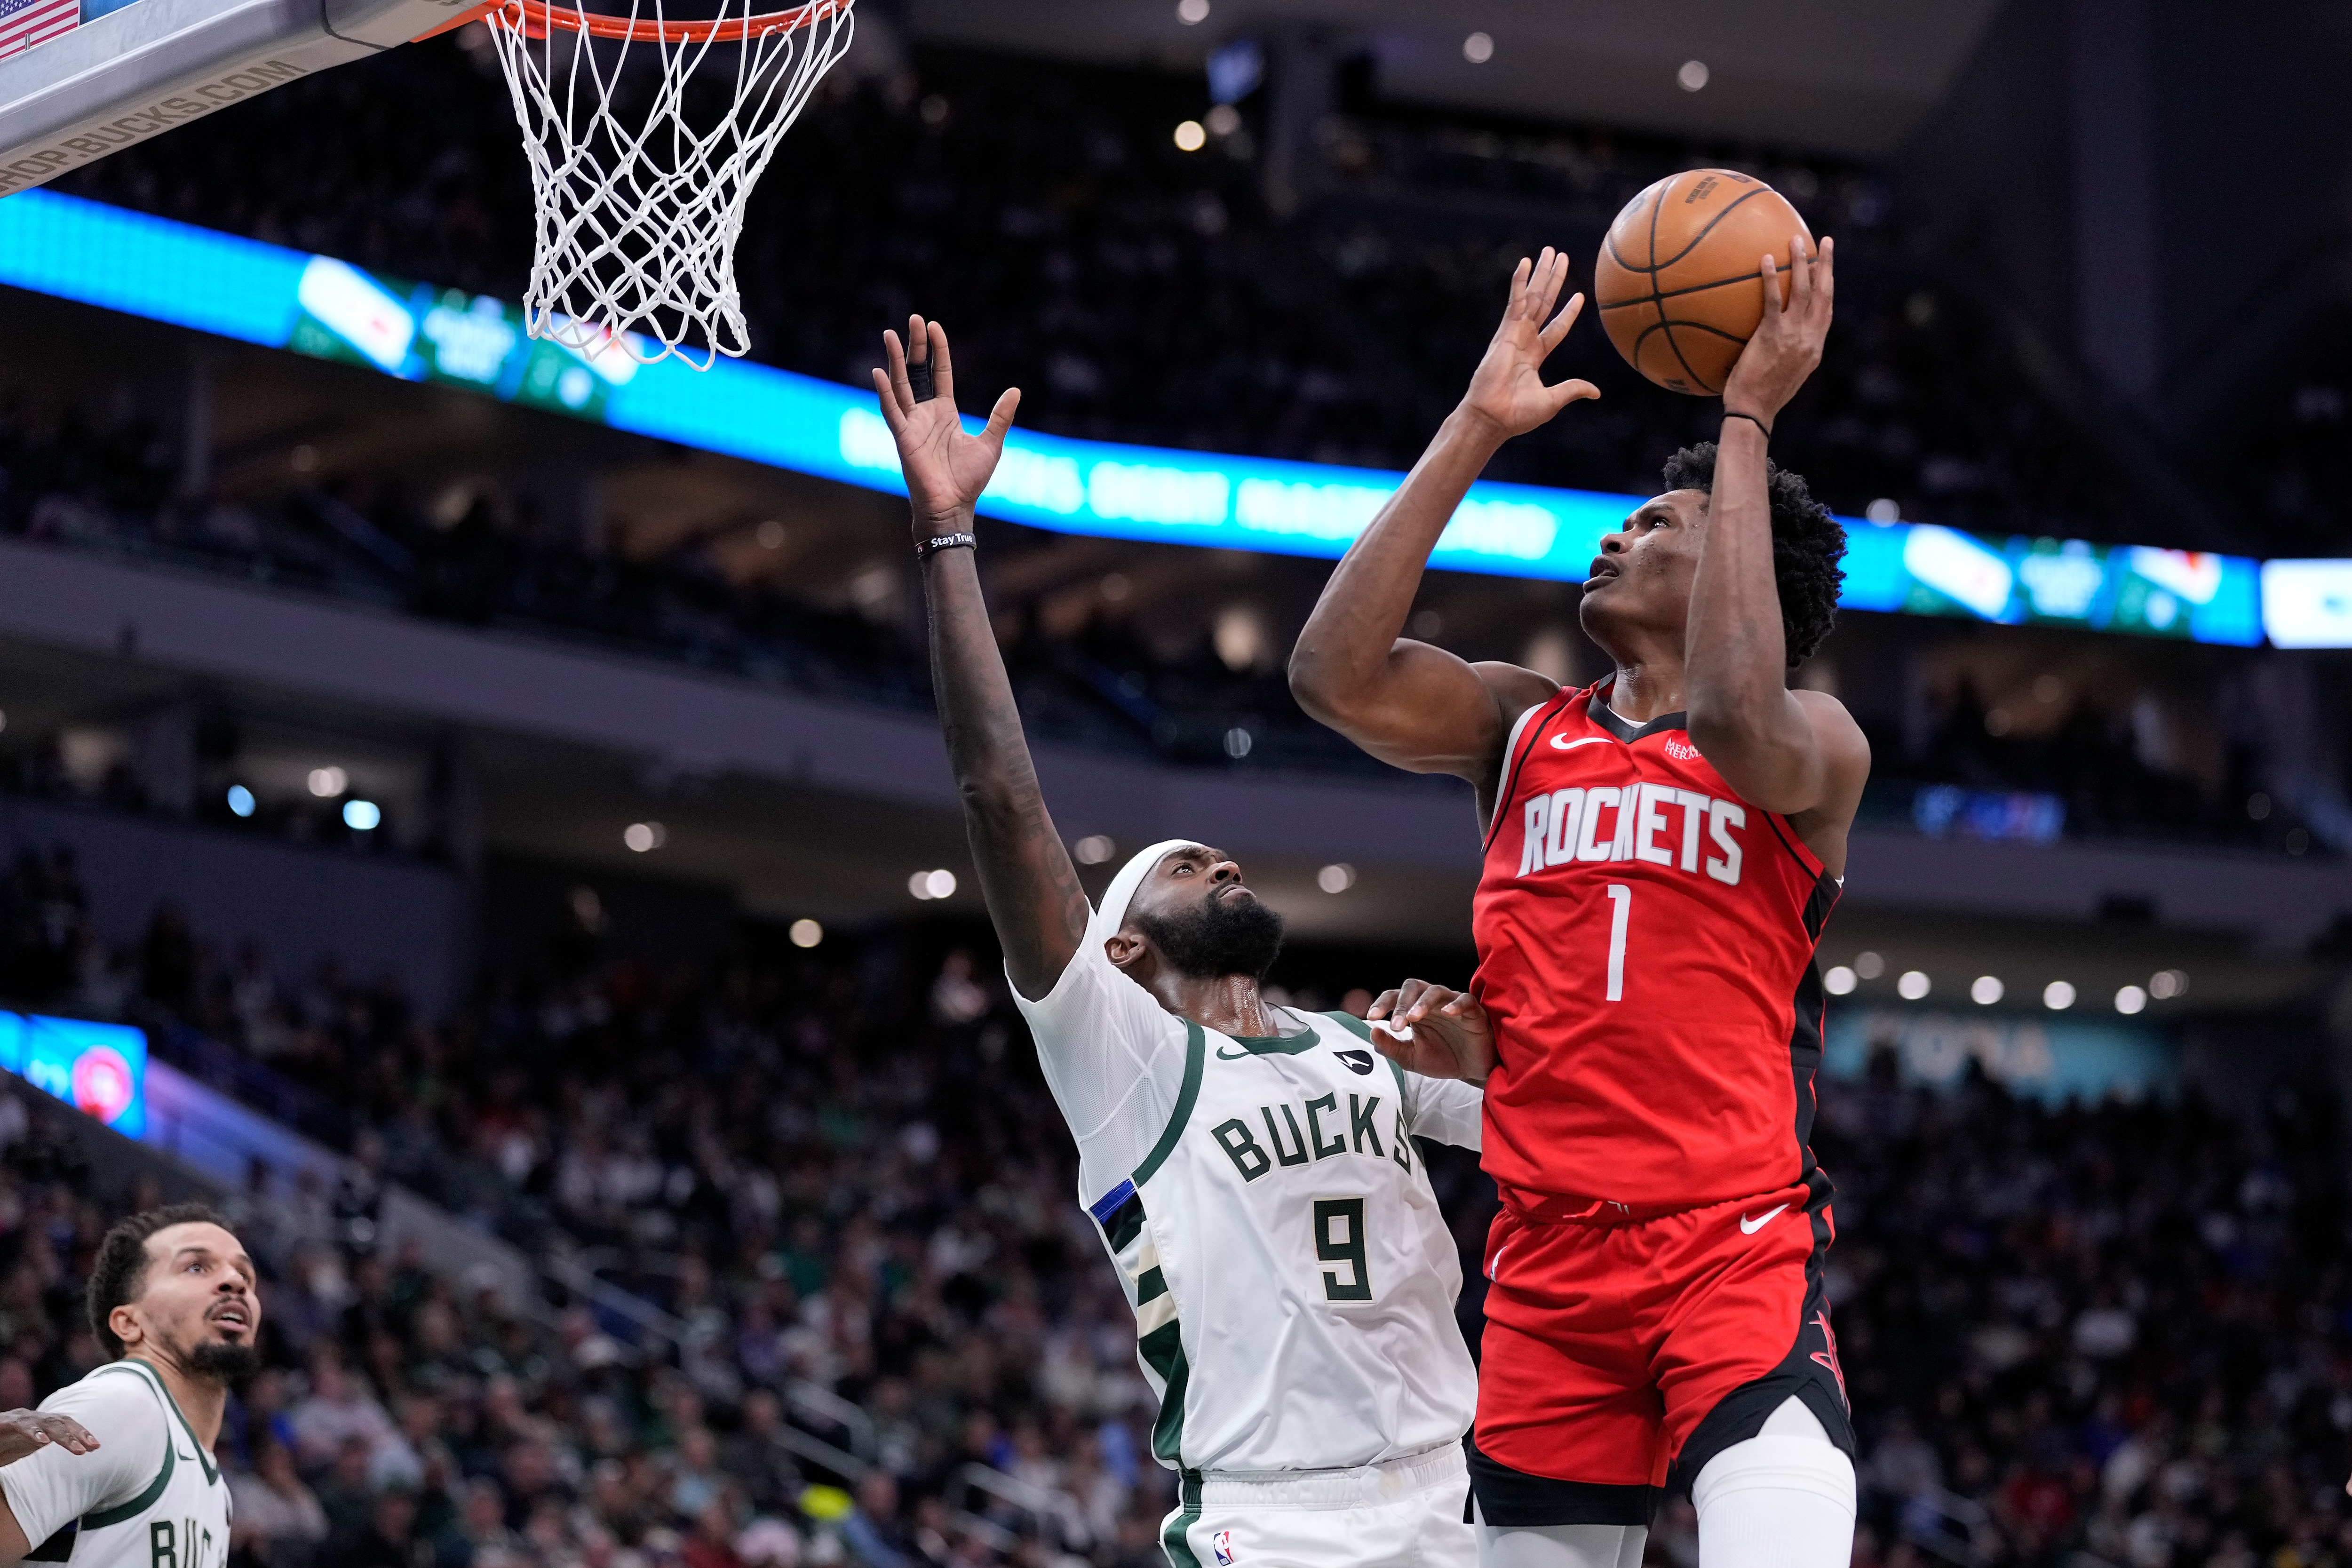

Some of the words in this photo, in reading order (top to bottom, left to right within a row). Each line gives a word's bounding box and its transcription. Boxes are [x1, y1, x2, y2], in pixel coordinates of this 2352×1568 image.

[0, 60, 308, 192] HOP.BUCKS.COM
[931, 536, 954, 548] Stay
[955, 533, 973, 542] True
[1665, 737, 1696, 753] MEM
[1668, 747, 1702, 760] HERM
[1516, 782, 1746, 886] ROCKETS
[1607, 884, 1631, 1002] 1
[1209, 1090, 1412, 1186] BUCKS
[1311, 1197, 1376, 1304] 9
